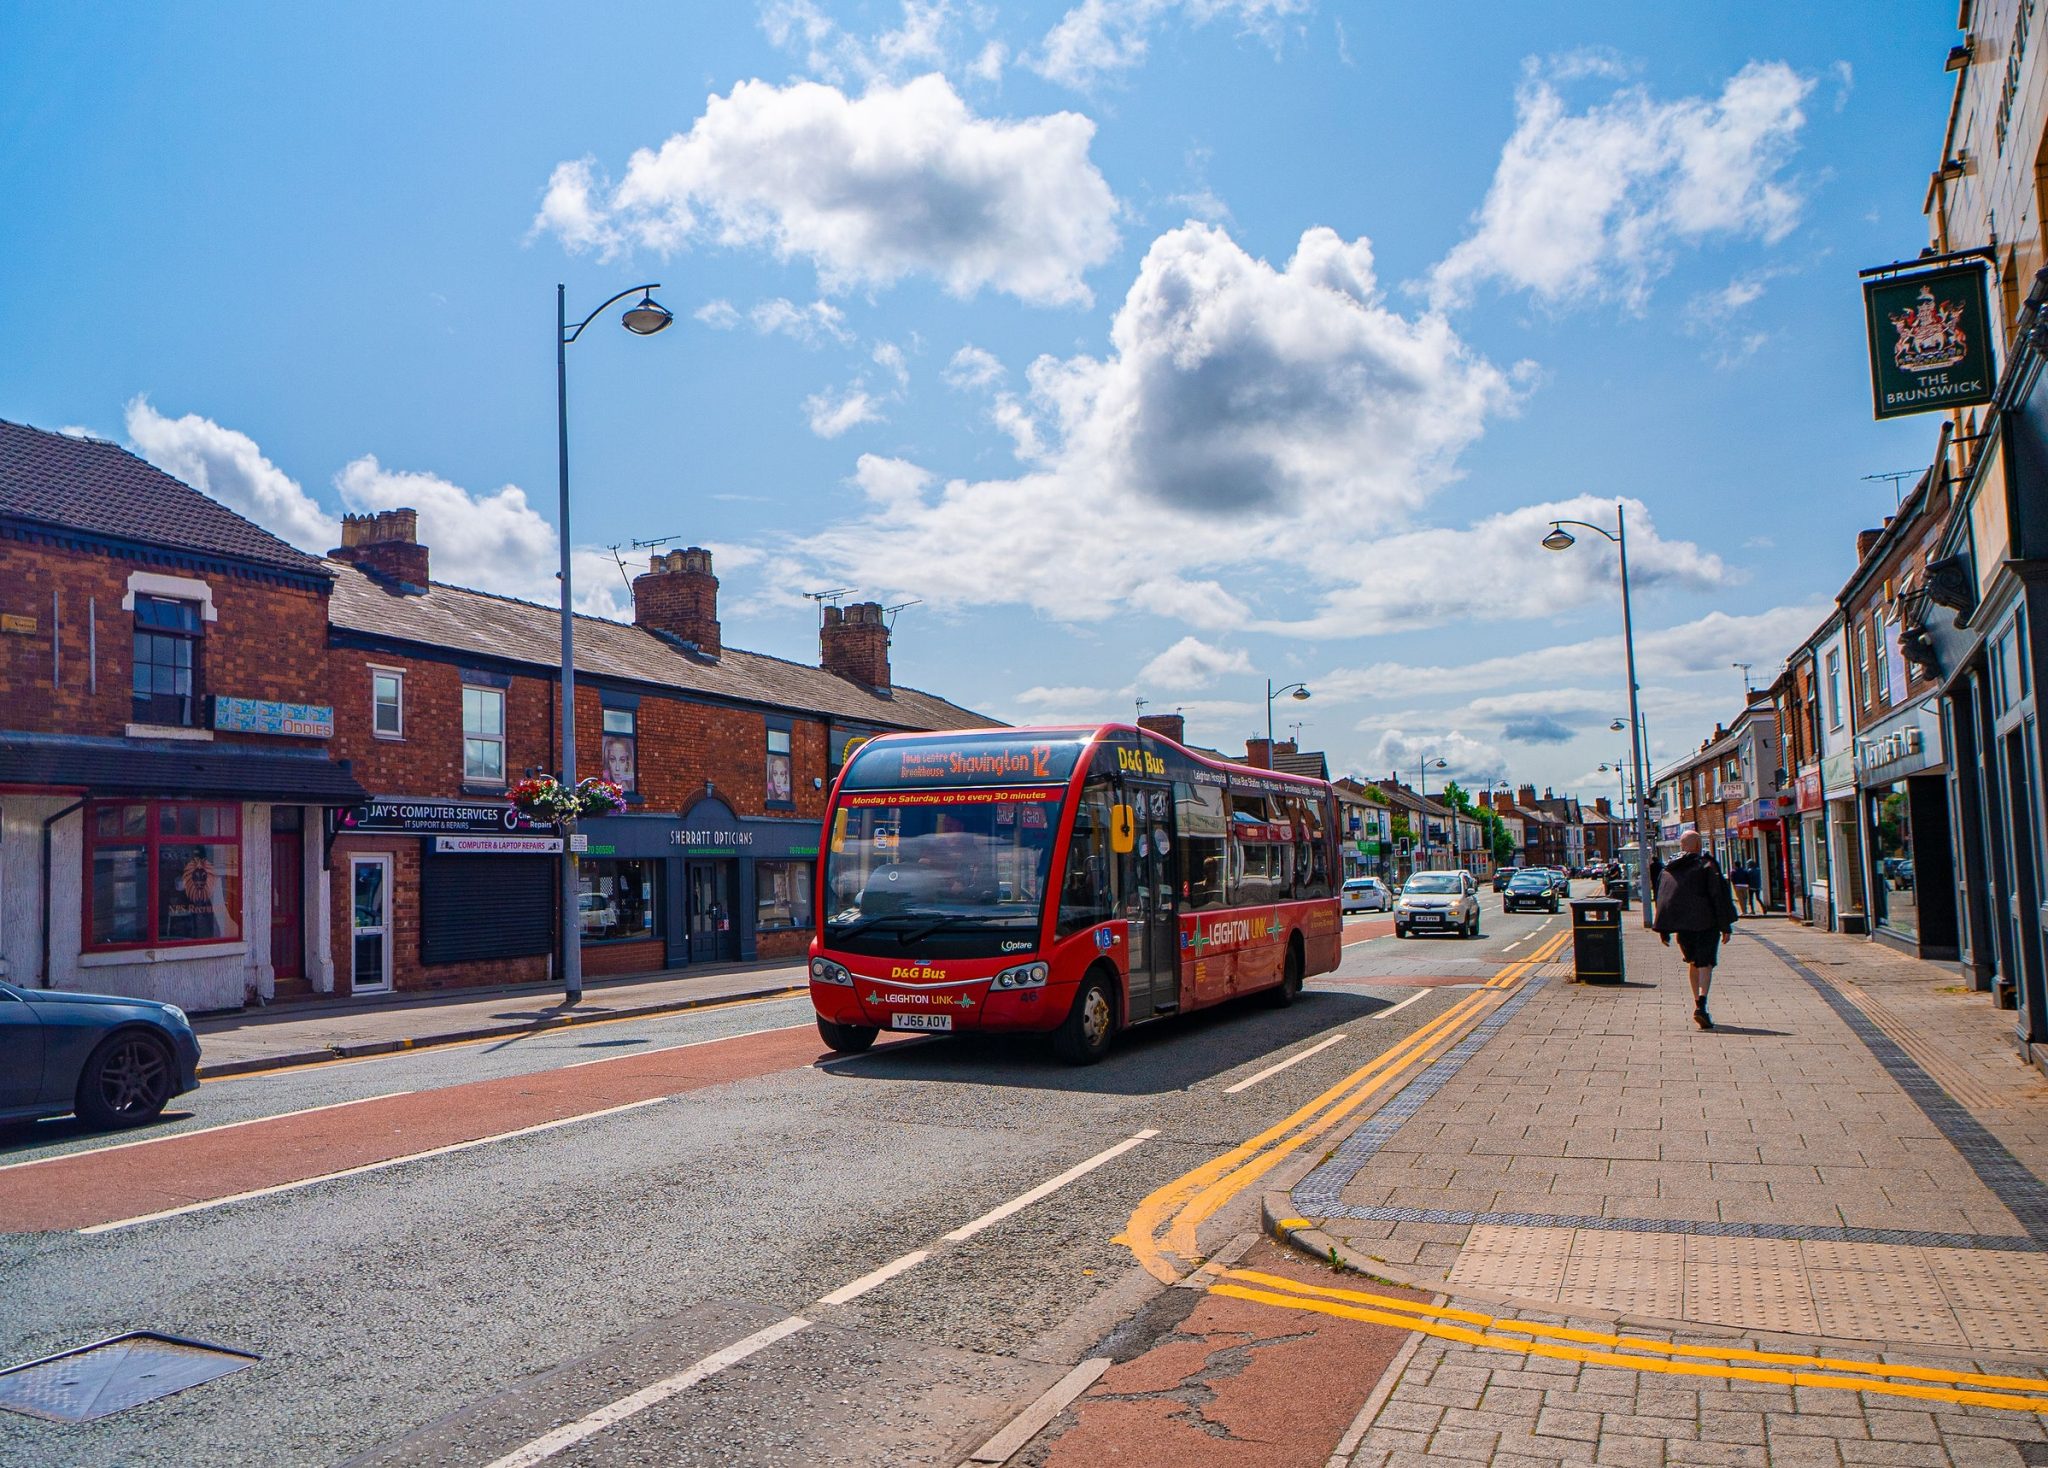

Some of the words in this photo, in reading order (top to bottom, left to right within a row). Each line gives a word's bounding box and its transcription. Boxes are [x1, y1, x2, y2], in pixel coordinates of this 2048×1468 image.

[1918, 373, 1949, 387] THE
[1887, 380, 1982, 404] BRUNSWICK
[283, 719, 332, 737] ODDIES
[949, 749, 1030, 776] Shavington
[1031, 744, 1051, 777] 12
[1118, 747, 1143, 772] D&G
[1144, 751, 1165, 775] Bus
[852, 795, 887, 806] Monday
[887, 795, 897, 803] to
[898, 793, 941, 804] Saturday,
[943, 793, 955, 803] up
[956, 792, 966, 801] to
[967, 791, 993, 801] every
[994, 790, 1008, 799] 30
[1009, 789, 1046, 798] minutes
[370, 805, 398, 818] JAY'S
[399, 805, 455, 820] COMPUTER
[456, 808, 498, 821] SERVICES
[404, 820, 411, 829] IT
[411, 820, 441, 830] SUPPORT
[446, 821, 470, 831] REPAIRS
[670, 830, 711, 845] SHERRATT
[713, 831, 753, 845] OPTICIANS
[458, 841, 493, 850] COMPUTER
[498, 841, 523, 850] LAPTOP
[522, 841, 546, 851] REPAIRS
[1209, 919, 1249, 946] LEIGHTON
[1250, 917, 1267, 939] LINK
[1005, 940, 1033, 951] Optare
[891, 967, 920, 979] D&G
[921, 968, 946, 980] Bus
[884, 993, 929, 1005] LEIGHTON
[930, 994, 954, 1005] LINK
[896, 1014, 924, 1027] YJ66
[926, 1015, 948, 1028] AOV
